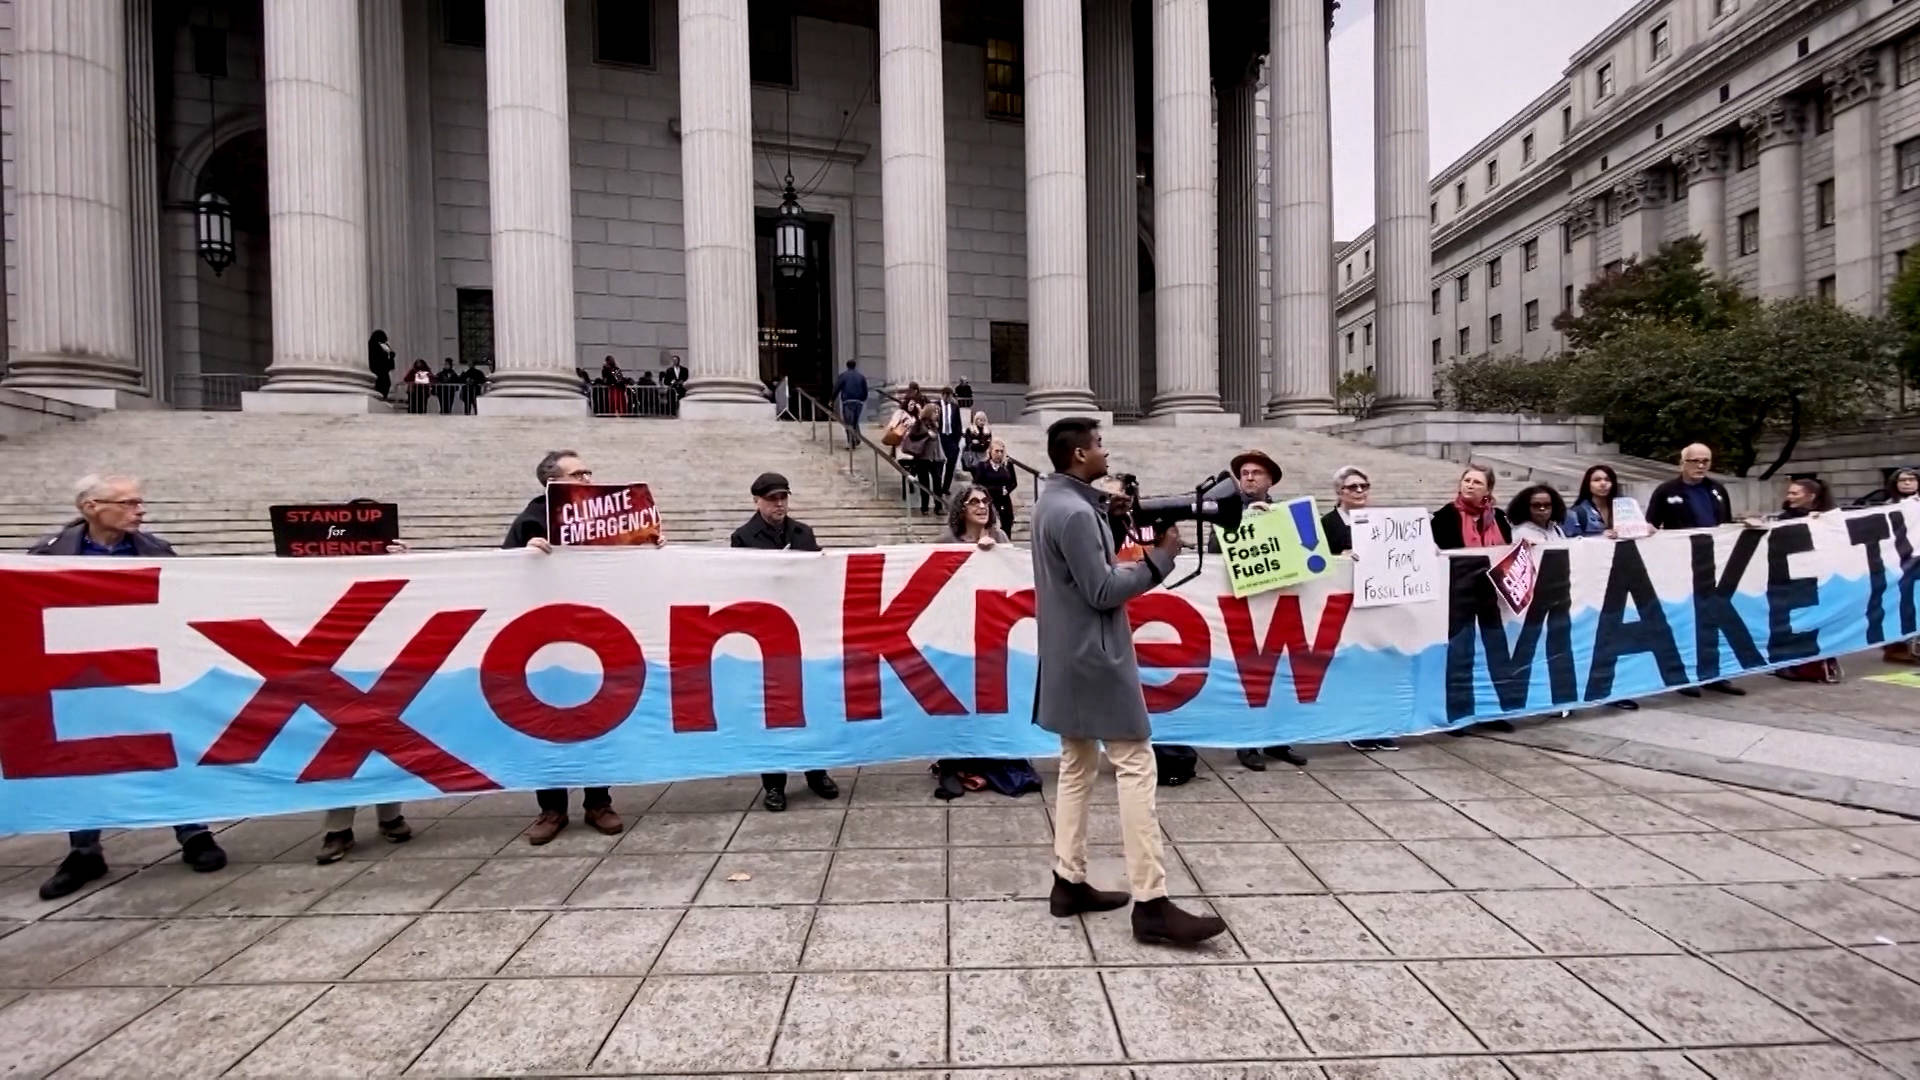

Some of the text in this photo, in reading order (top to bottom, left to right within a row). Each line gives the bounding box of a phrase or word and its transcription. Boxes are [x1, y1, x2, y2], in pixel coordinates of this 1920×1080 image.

[286, 508, 383, 523] STAND UP
[562, 488, 633, 525] CLIMATE
[326, 525, 347, 540] for
[560, 505, 658, 546] EMERGENCY
[1223, 523, 1255, 544] Off
[1227, 536, 1280, 561] Fossil
[1232, 558, 1281, 580] Fuels
[1364, 575, 1431, 601] FOSSIL FUELS
[1446, 523, 1821, 723] MAKE
